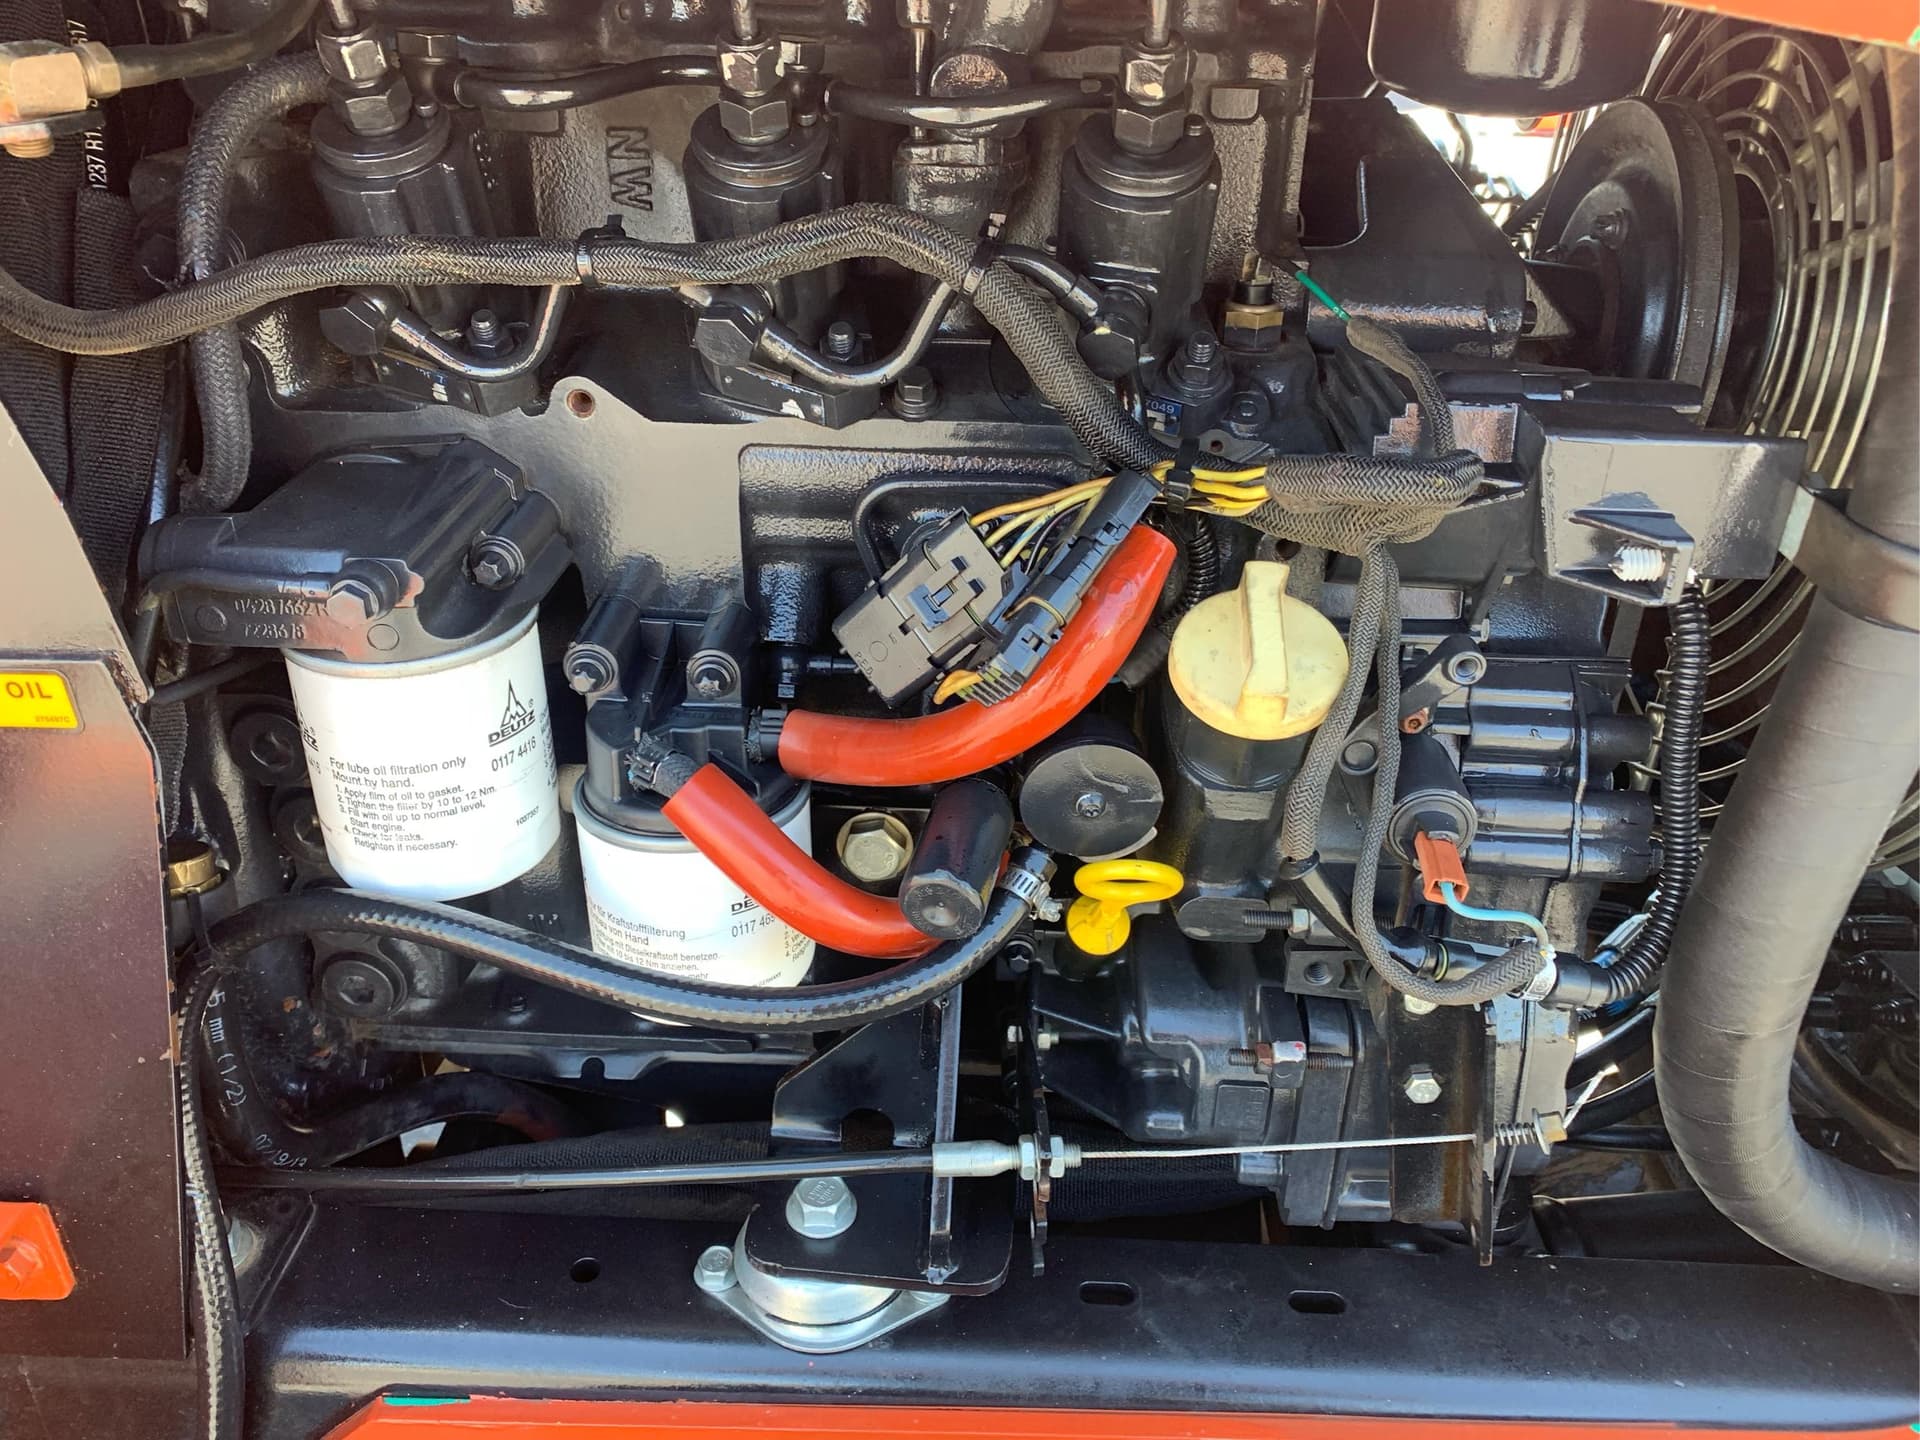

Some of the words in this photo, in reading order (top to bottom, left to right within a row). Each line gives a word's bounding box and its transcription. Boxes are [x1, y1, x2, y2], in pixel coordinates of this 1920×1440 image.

[5, 681, 53, 699] OIL
[488, 709, 536, 744] DEUTZ
[491, 749, 515, 772] 0117
[516, 736, 537, 759] 4416
[329, 756, 345, 770] For
[346, 762, 370, 775] lube
[373, 765, 387, 776] oil
[389, 762, 438, 776] filtration
[442, 756, 466, 769] only
[331, 769, 361, 785] Mount
[363, 777, 378, 790] by
[380, 777, 415, 788] hand.
[344, 786, 367, 800] Apply
[368, 791, 386, 800] film
[388, 792, 398, 801] of
[400, 791, 412, 801] oil
[415, 791, 425, 800] to
[428, 785, 464, 799] gasket.
[344, 796, 377, 810] Tighten
[378, 802, 394, 811] the
[421, 800, 434, 811] by
[438, 797, 449, 807] 10
[452, 795, 462, 804] to
[465, 791, 477, 801] 12
[479, 785, 497, 797] Nm.
[347, 806, 360, 817] Fill
[362, 811, 380, 820] with
[382, 812, 393, 822] oil
[395, 814, 408, 823] up
[411, 812, 421, 821] to
[423, 806, 458, 820] normal
[350, 816, 370, 829] Start
[371, 822, 405, 833] engine.
[352, 826, 377, 839] Check
[380, 832, 392, 841] for
[394, 832, 424, 841] leaks.
[354, 836, 394, 851] Retighten
[405, 839, 458, 852] necessary.
[731, 897, 759, 913] DE
[608, 924, 622, 938] von
[624, 930, 649, 946] Hand
[731, 919, 756, 938] 0117
[625, 943, 678, 961] Dieselkraftstoff
[635, 956, 645, 966] 12
[646, 959, 659, 968] Nm
[208, 1017, 225, 1043] mm
[216, 1053, 247, 1107] (1/2)
